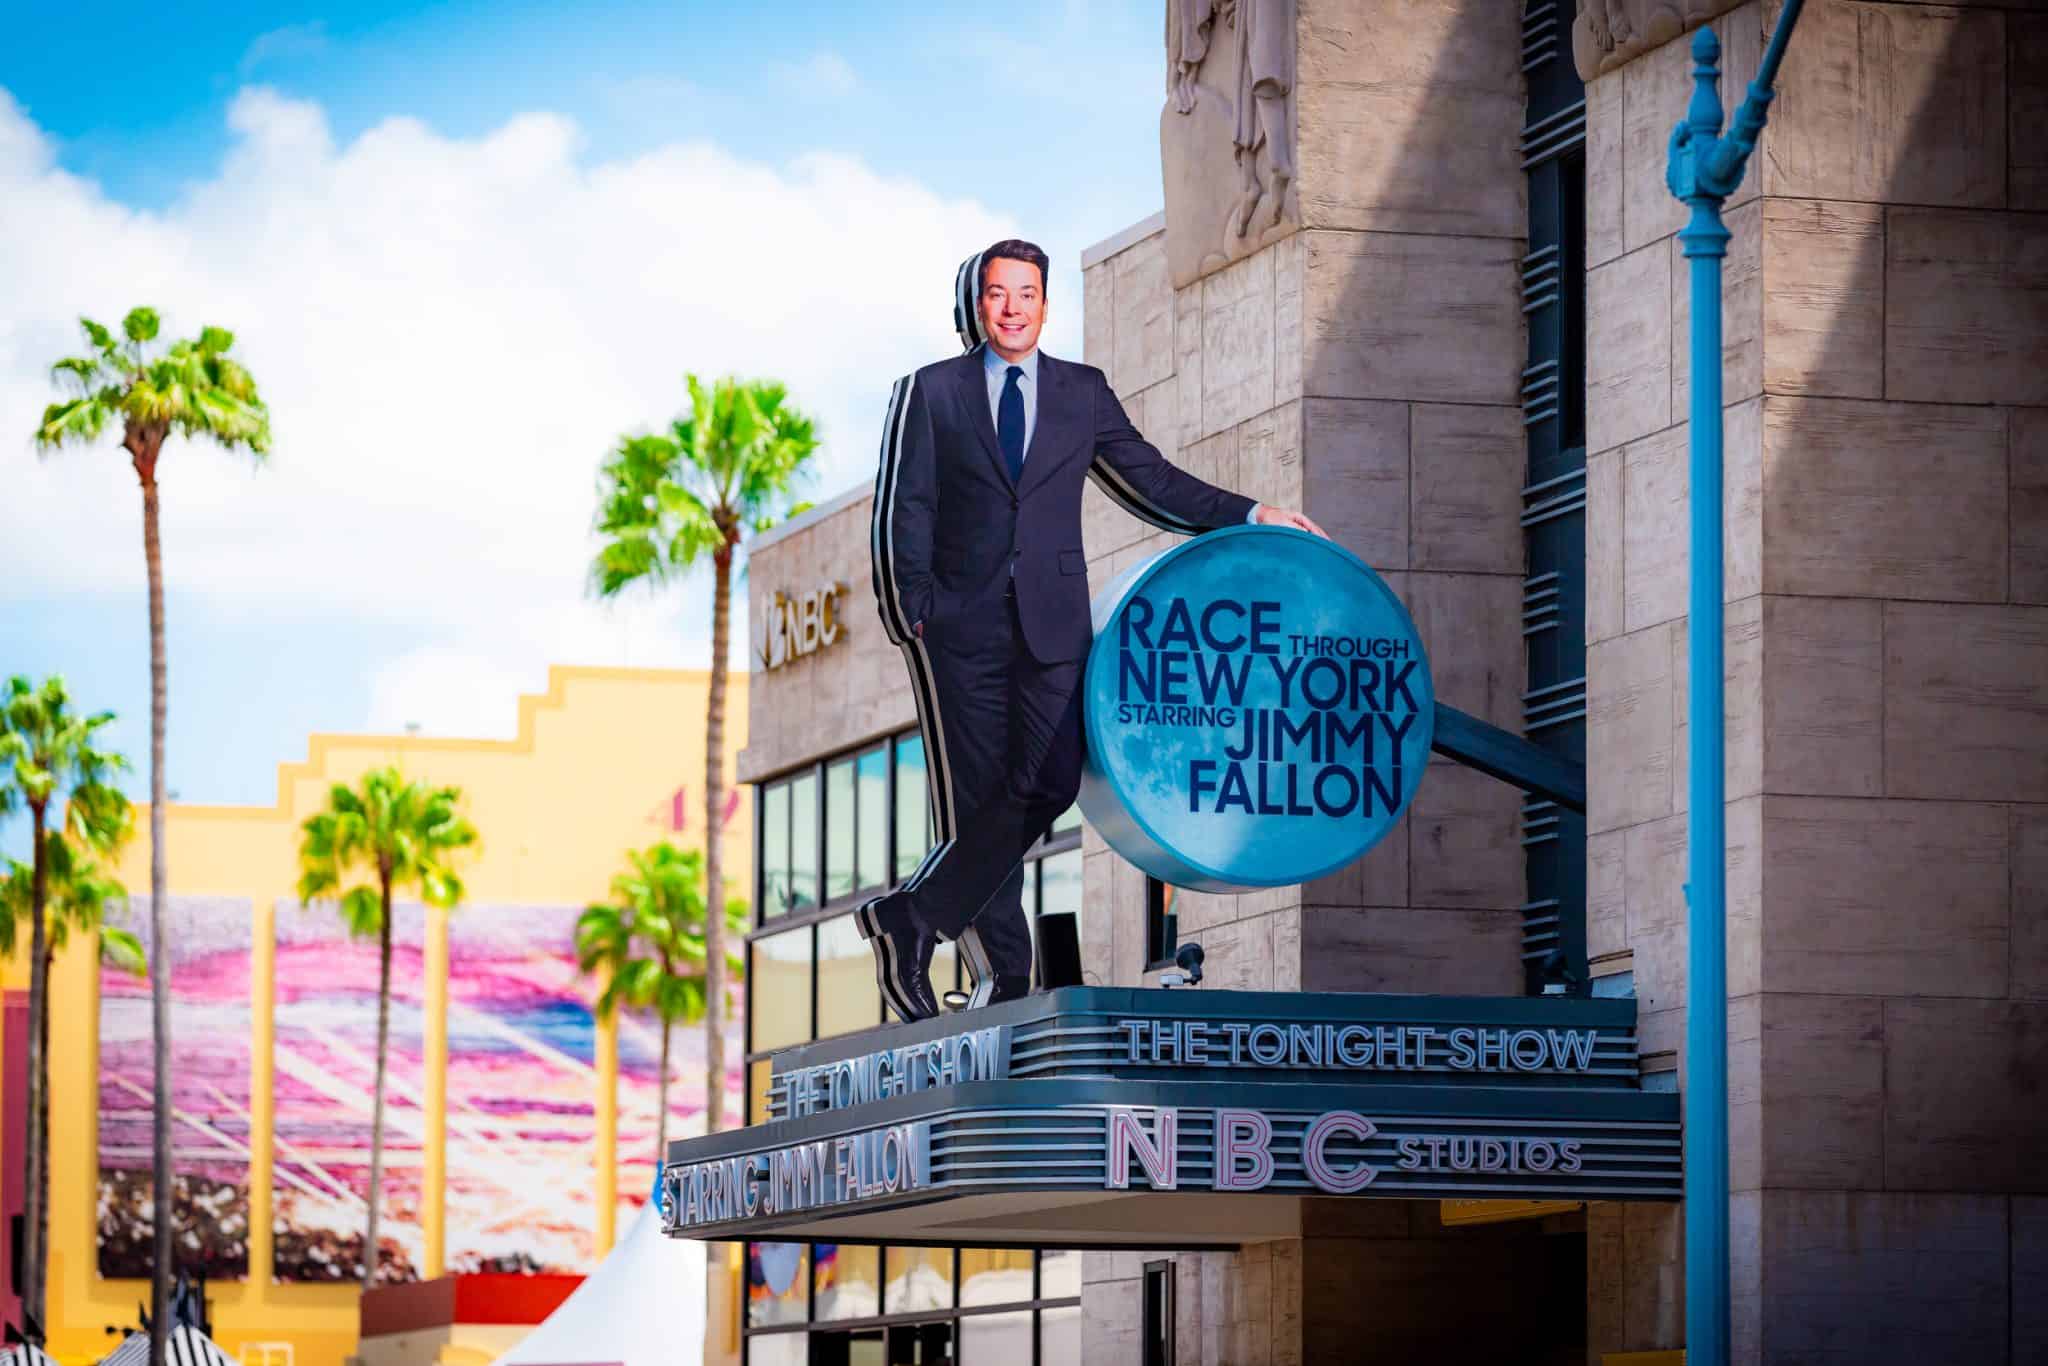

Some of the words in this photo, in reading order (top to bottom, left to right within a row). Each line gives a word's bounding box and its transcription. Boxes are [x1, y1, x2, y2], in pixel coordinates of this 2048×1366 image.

[785, 580, 845, 660] NBC
[1120, 595, 1281, 654] RACE
[1288, 635, 1409, 659] THROUGH
[1119, 650, 1253, 706] NEW
[1269, 656, 1419, 713] YORK
[1118, 703, 1237, 728] STARRING
[1224, 708, 1417, 765] JIMMY
[1190, 760, 1402, 818] FALLON
[782, 1066, 822, 1120] THE
[825, 1045, 925, 1108] TONIGHT
[927, 1024, 1002, 1089] SHOW
[1119, 1020, 1209, 1064] THE
[1222, 1022, 1436, 1067] TONIGHT
[1449, 1026, 1598, 1071] SHOW
[662, 1156, 760, 1228] STARRING
[764, 1141, 829, 1216] JIMMY
[835, 1123, 920, 1200] FALLON
[1104, 1106, 1379, 1194] NBC
[1398, 1136, 1583, 1173] STUDIOS
